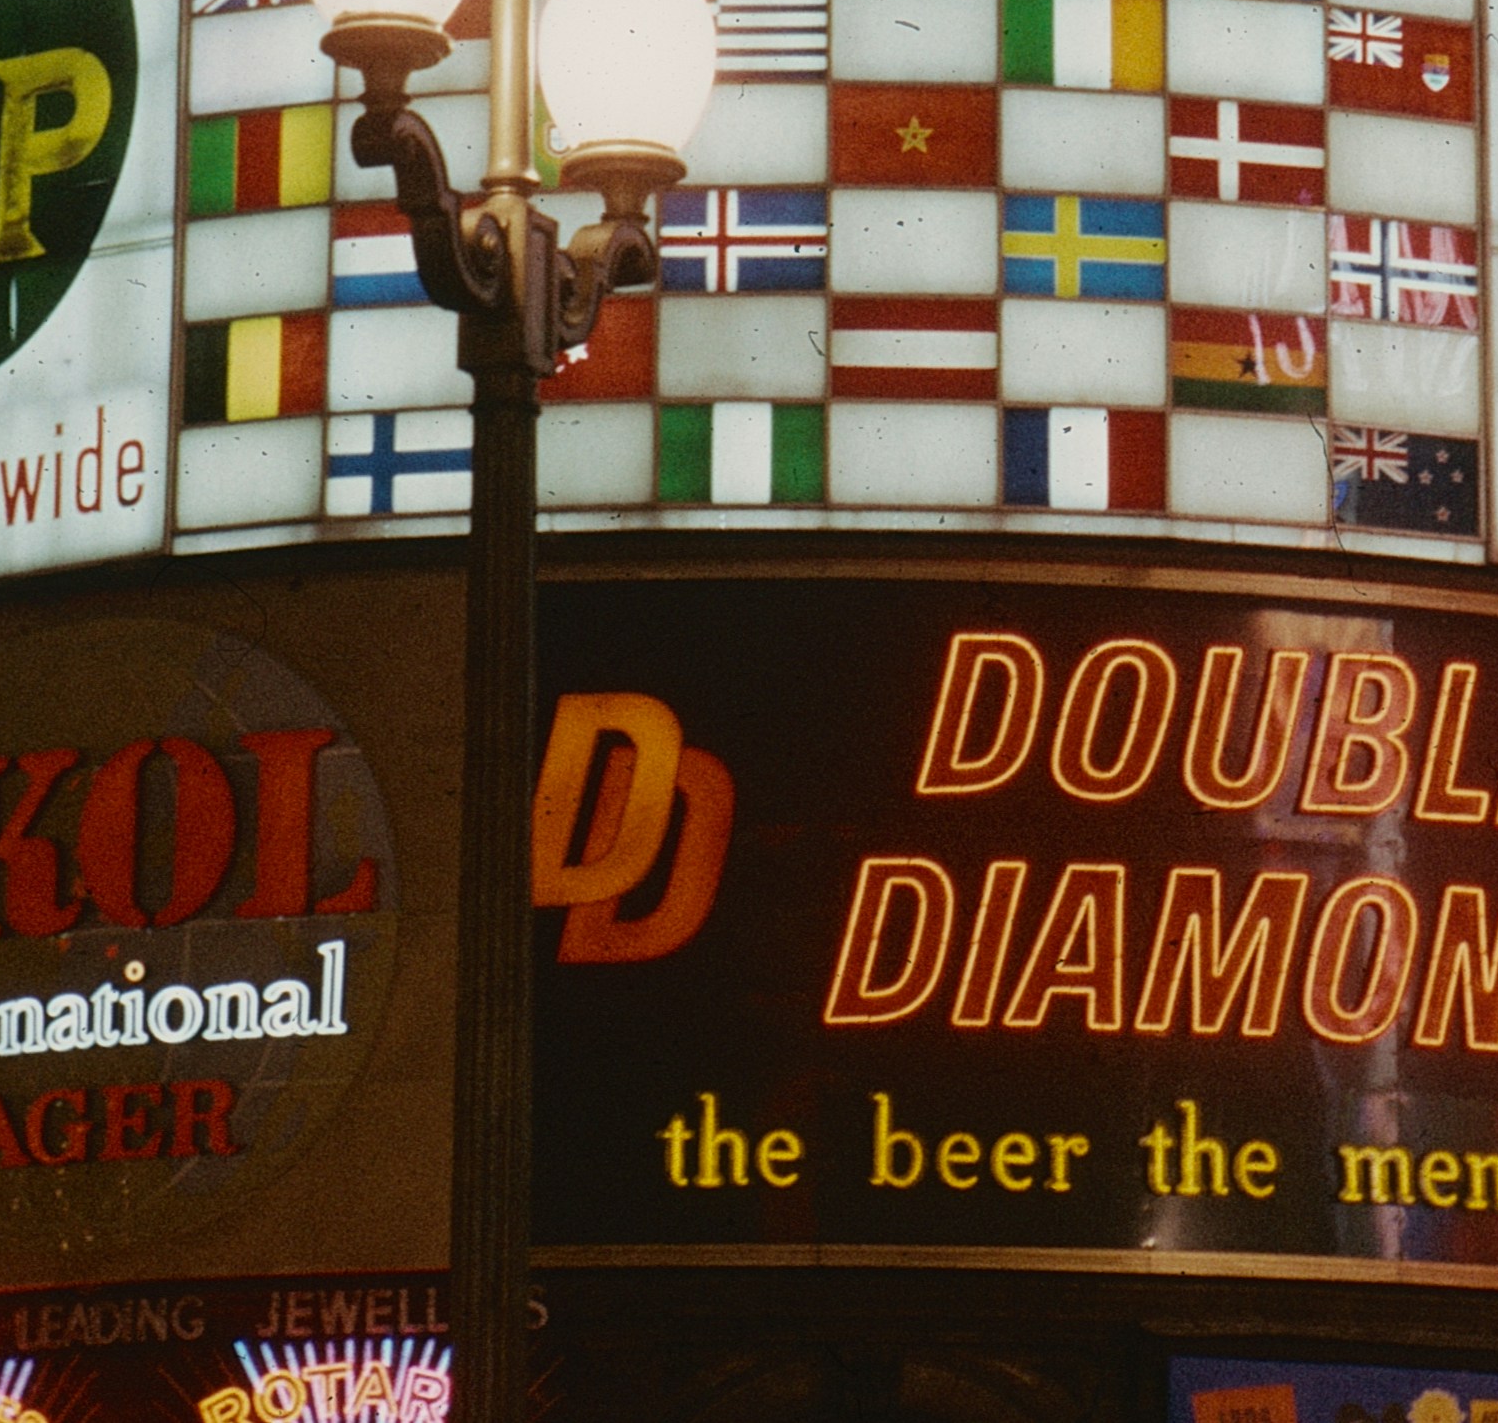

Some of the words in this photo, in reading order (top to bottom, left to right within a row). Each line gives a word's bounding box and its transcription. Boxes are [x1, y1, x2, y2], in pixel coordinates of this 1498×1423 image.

[657, 1091, 804, 1190] the
[867, 1090, 1091, 1192] beer
[1137, 1099, 1281, 1199] the
[12, 1294, 205, 1351] LEADING
[255, 1283, 549, 1340] JEWELLS
[198, 1360, 455, 1423] ROTAR
